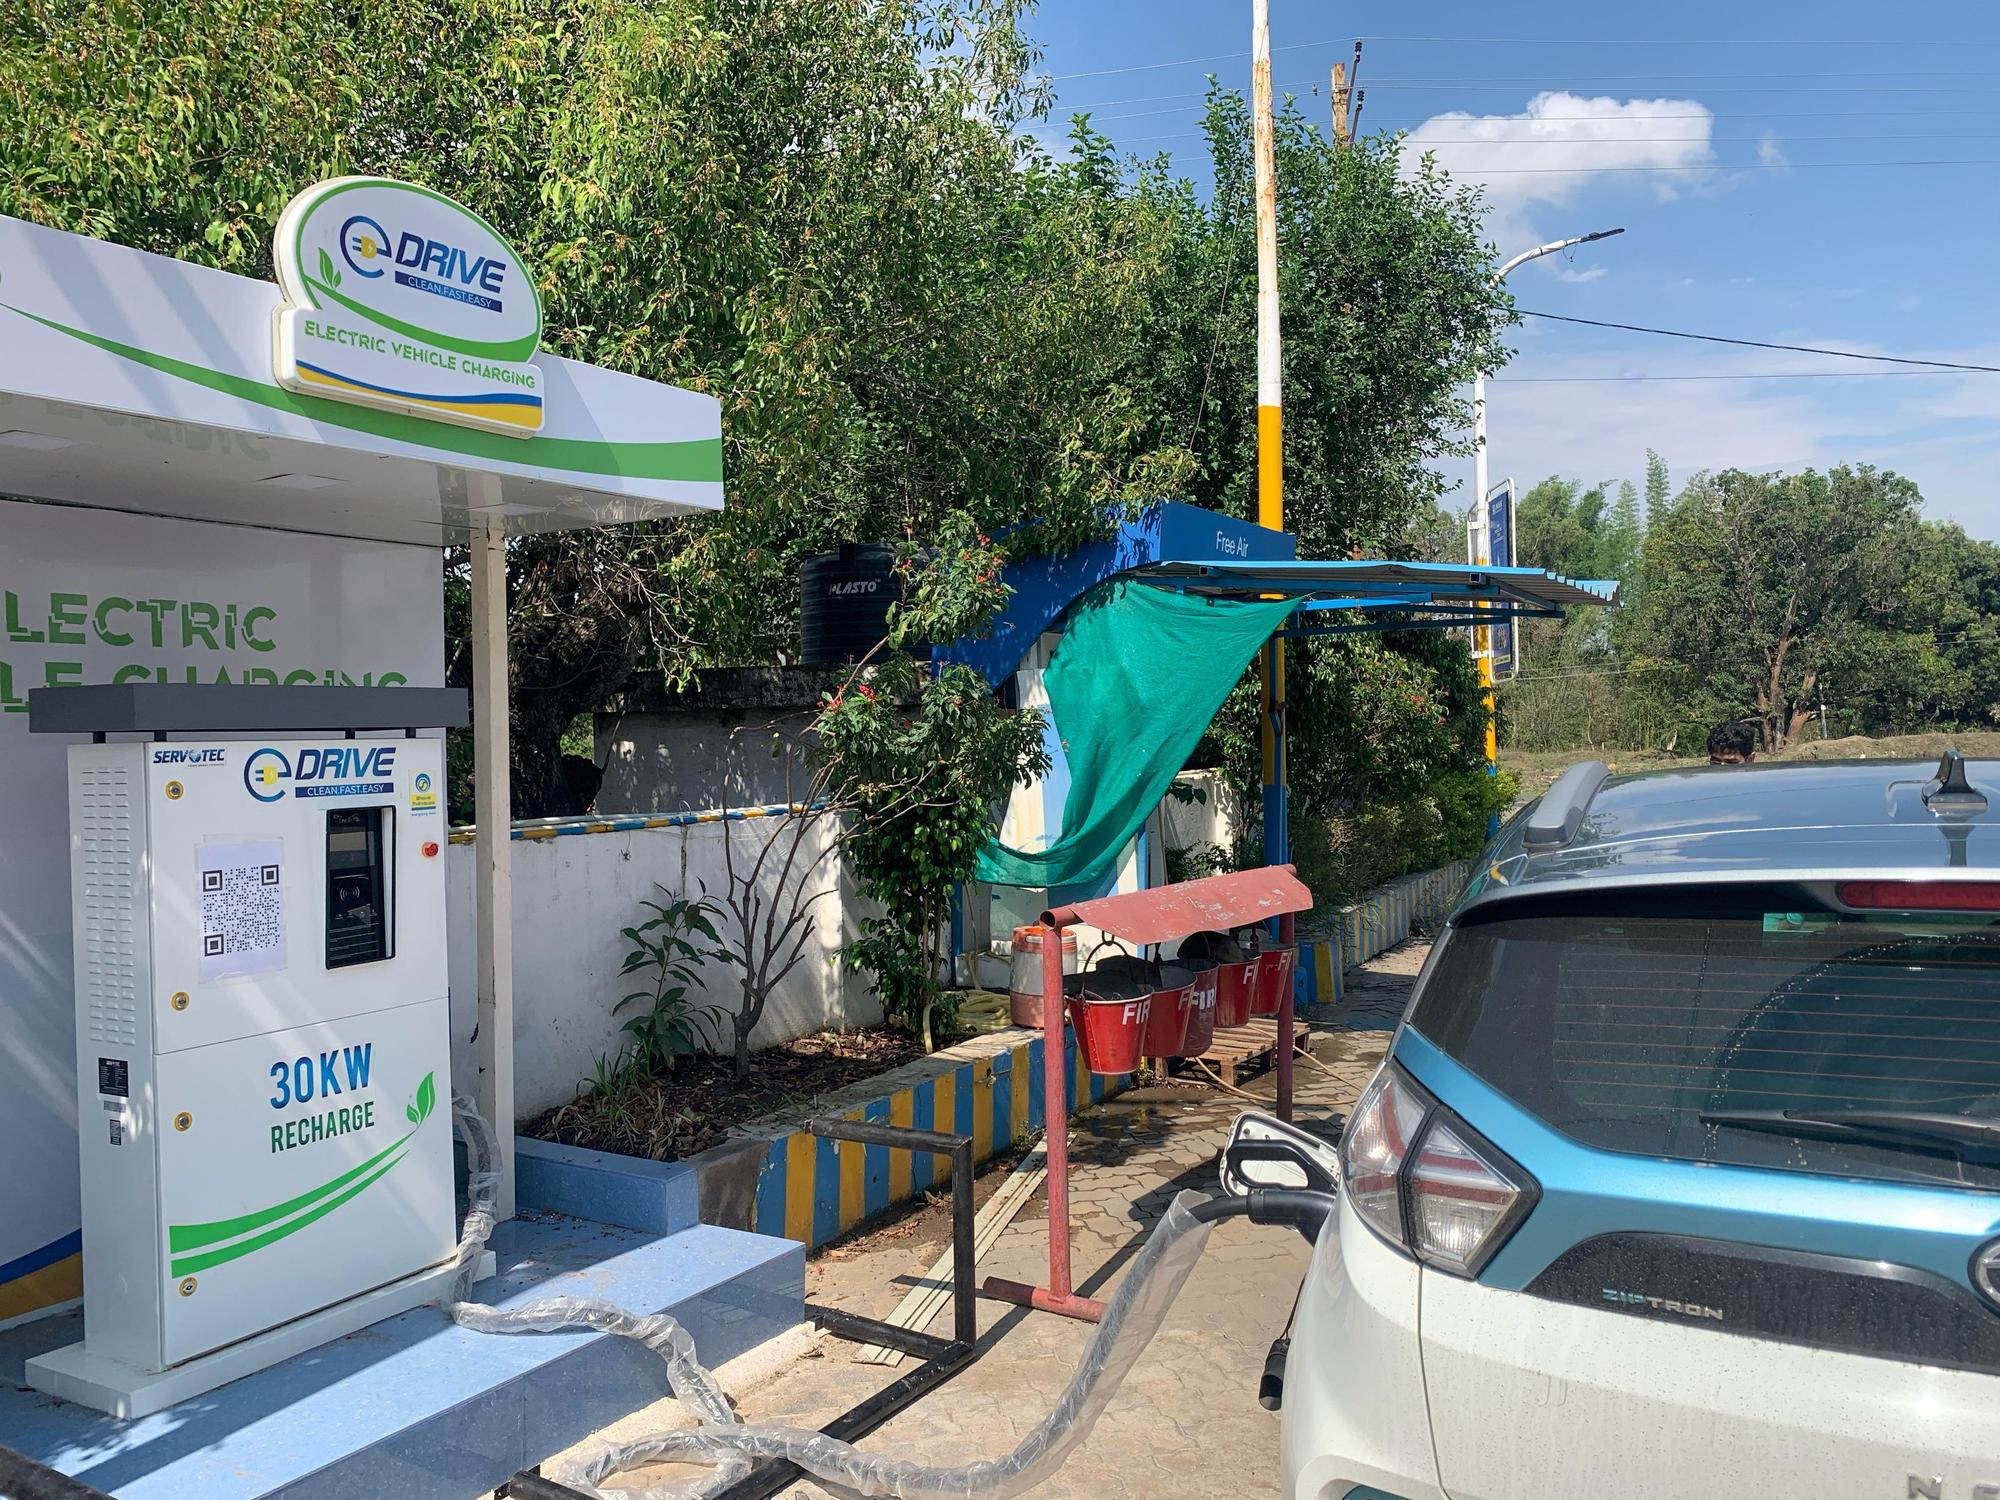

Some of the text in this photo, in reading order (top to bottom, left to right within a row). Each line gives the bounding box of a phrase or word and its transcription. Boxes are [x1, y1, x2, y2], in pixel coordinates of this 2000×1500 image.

[304, 320, 536, 388] ELECTRIC VEHICLE CHARGING
[1216, 530, 1249, 557] Free Air
[5, 590, 277, 652] LECTRIC
[269, 1042, 373, 1111] 30KW
[271, 1100, 376, 1154] RECHARGE
